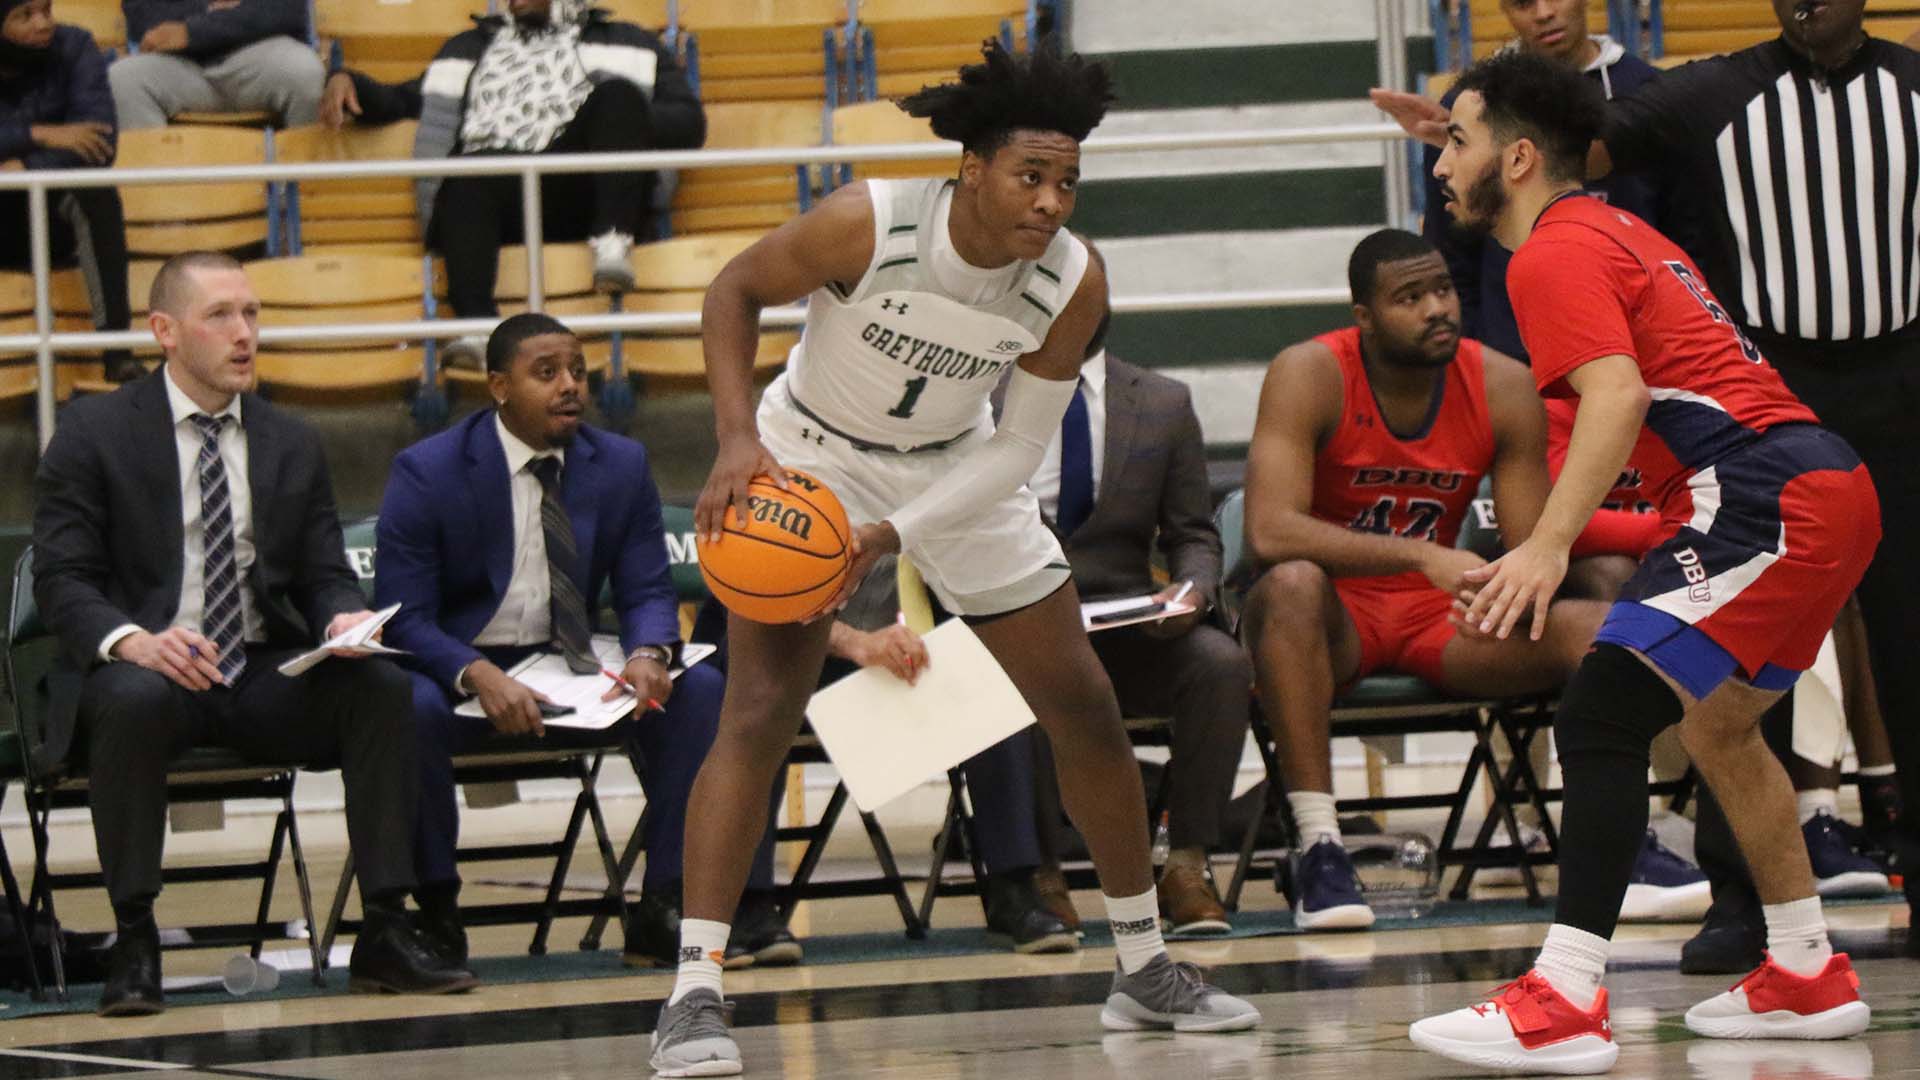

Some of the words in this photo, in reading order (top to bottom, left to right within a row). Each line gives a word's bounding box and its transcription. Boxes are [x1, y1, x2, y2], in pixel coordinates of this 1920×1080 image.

[861, 322, 1011, 381] GREYHOUND
[887, 375, 928, 419] 1
[1352, 466, 1466, 493] DBU
[736, 494, 813, 541] Wils
[1673, 546, 1711, 603] DBU
